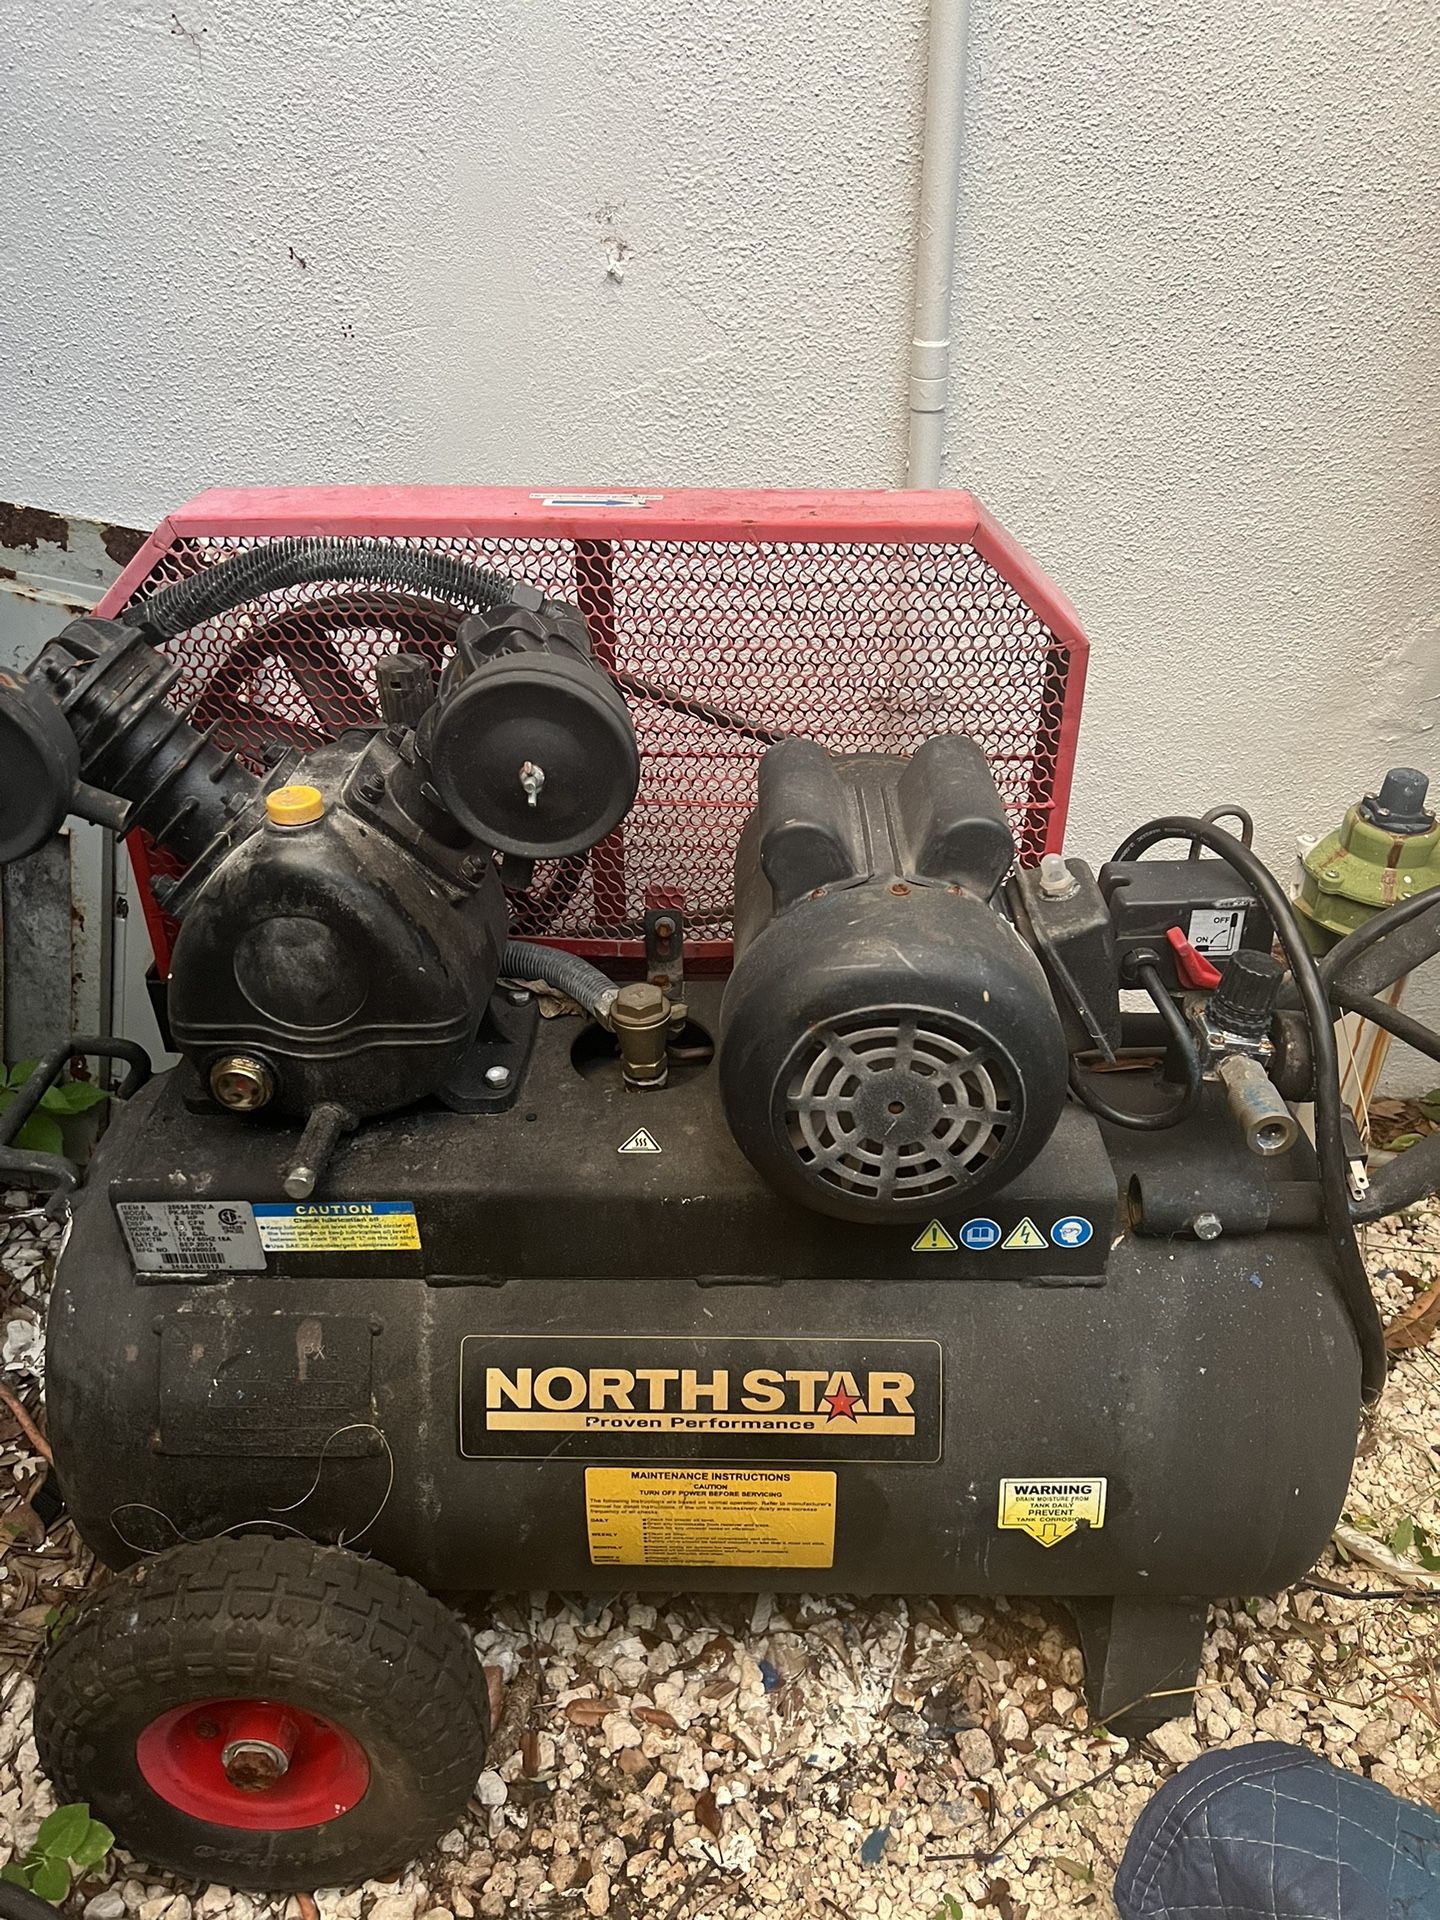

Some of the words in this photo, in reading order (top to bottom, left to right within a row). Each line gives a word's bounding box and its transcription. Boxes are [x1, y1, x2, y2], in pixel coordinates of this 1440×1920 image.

[296, 1205, 373, 1214] CAUTION
[486, 1367, 729, 1412] NORTH
[741, 1370, 915, 1414] STAR
[586, 1416, 662, 1429] Proven
[671, 1417, 815, 1431] Performance
[631, 1472, 709, 1481] MAINTENANCE
[712, 1473, 791, 1482] INSTRUCTIONS
[1015, 1485, 1092, 1495] WARNING
